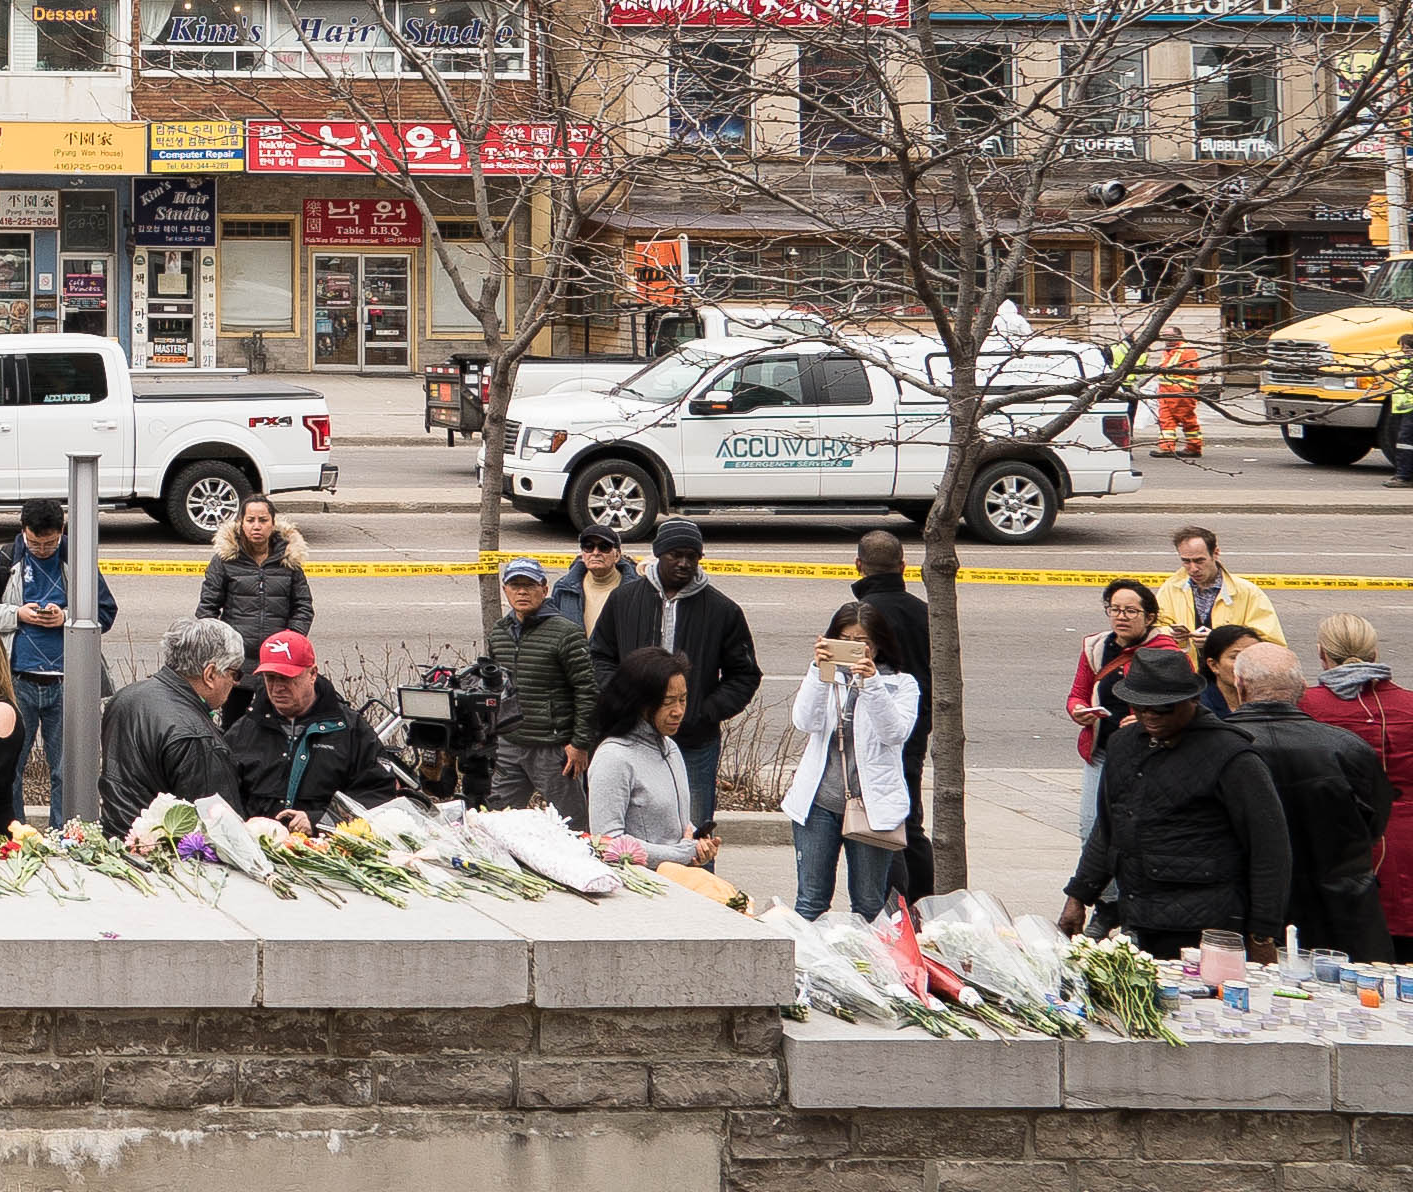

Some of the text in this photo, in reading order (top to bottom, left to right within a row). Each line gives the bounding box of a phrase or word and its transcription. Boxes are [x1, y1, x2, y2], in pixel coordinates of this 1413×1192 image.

[32, 7, 97, 23] Dessert
[166, 15, 515, 46] Kim's Hair Studo
[258, 141, 297, 150] NakWon
[318, 124, 462, 171] 낙원
[1200, 138, 1246, 153] BUBBLE
[159, 150, 236, 162] Computer Repair
[484, 147, 527, 160] Table
[139, 181, 173, 207] Kim's
[171, 191, 210, 205] Hair
[153, 205, 210, 221] Studio
[327, 200, 408, 226] 낙원
[335, 226, 403, 236] Table B.B.Q.
[154, 344, 187, 354] MASTERS
[249, 415, 293, 428] FX4
[714, 437, 849, 459] ACCUWORX
[735, 460, 845, 468] EMERGENCY SERVICES
